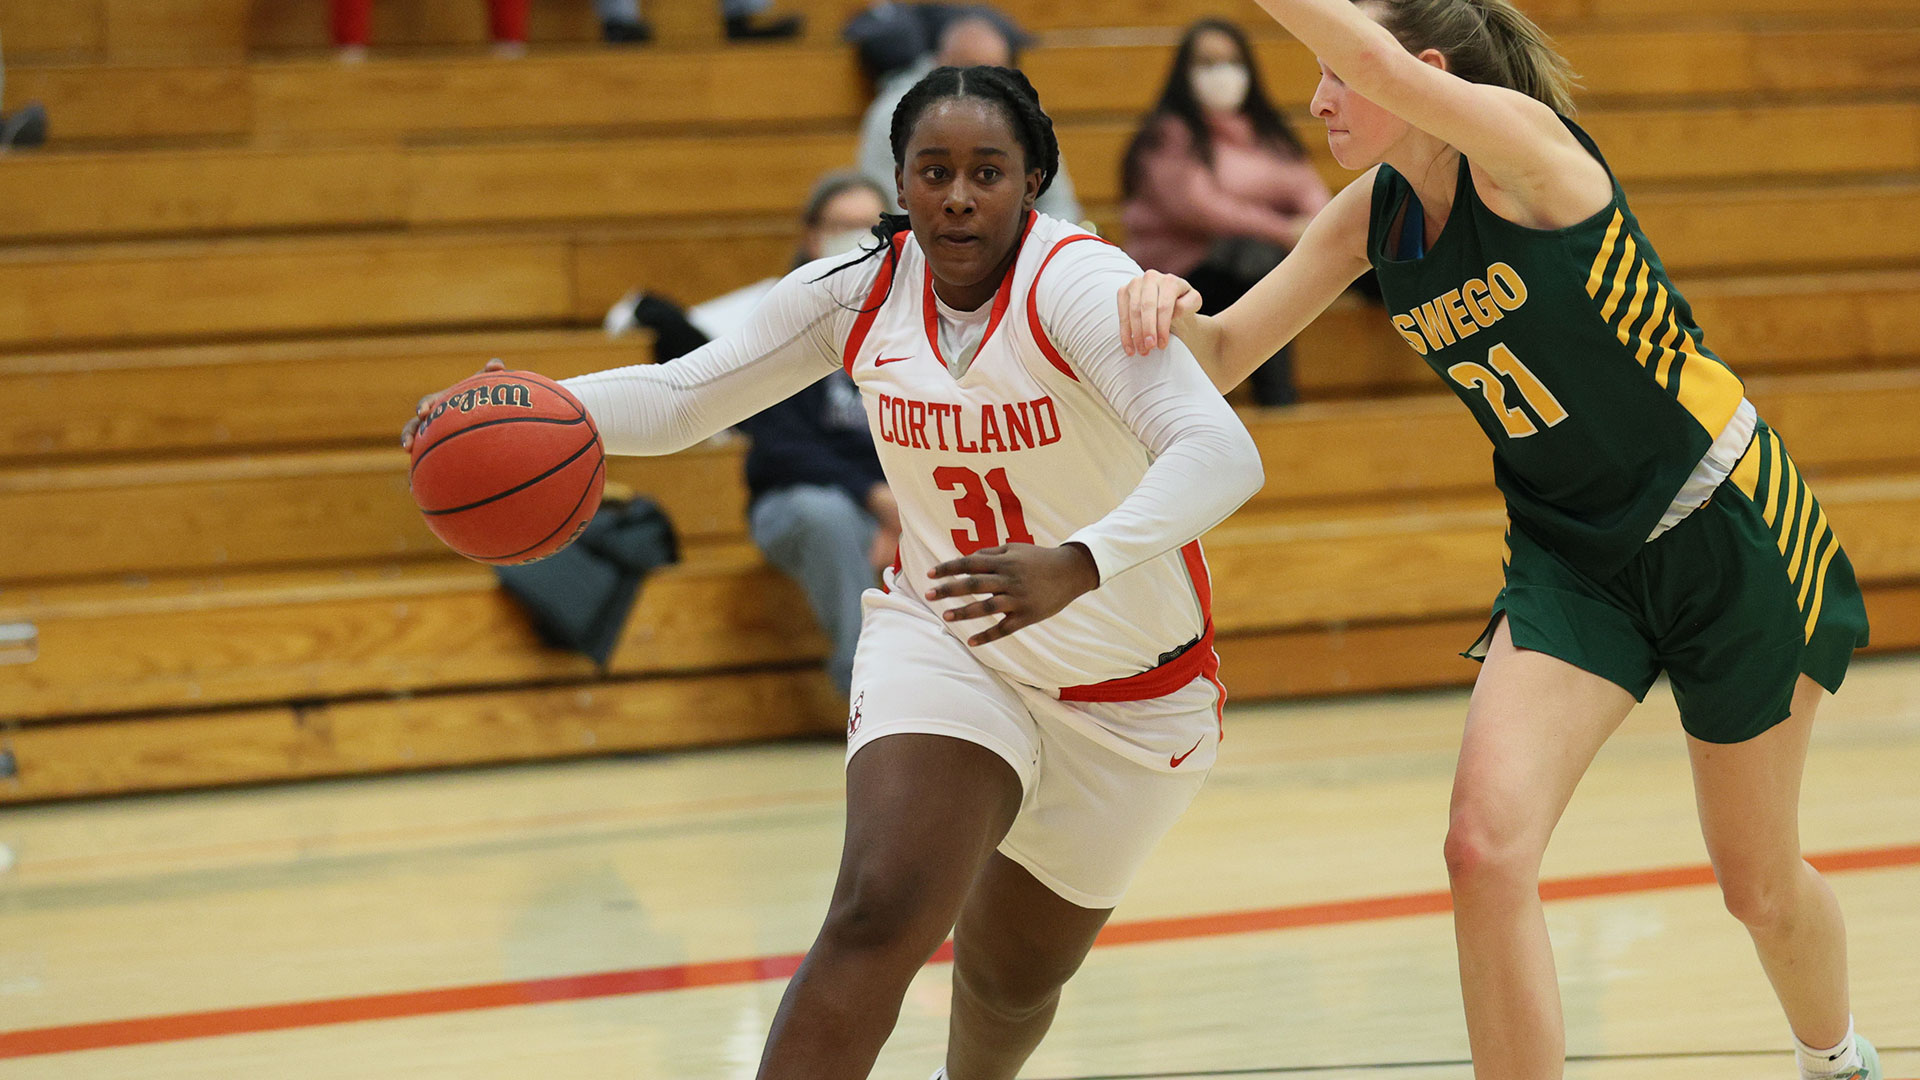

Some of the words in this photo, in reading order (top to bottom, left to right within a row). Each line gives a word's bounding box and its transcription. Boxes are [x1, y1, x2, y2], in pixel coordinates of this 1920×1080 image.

[1391, 262, 1528, 355] SWEGO
[879, 393, 1062, 453] CORTLAND
[1448, 342, 1569, 438] 21
[932, 466, 1035, 556] 31
